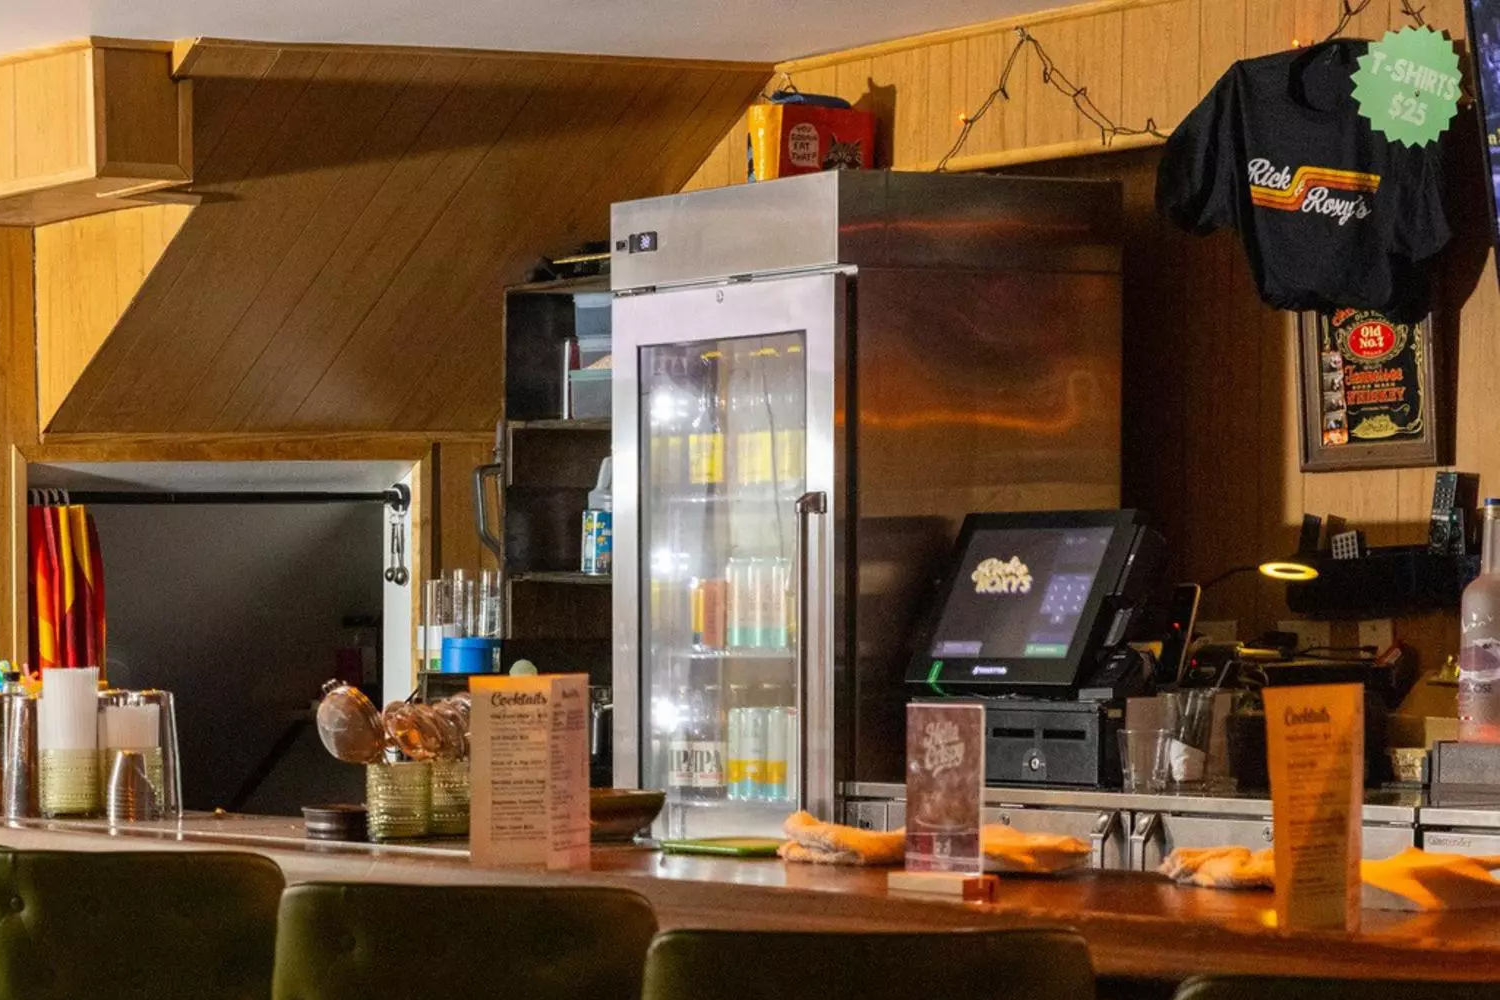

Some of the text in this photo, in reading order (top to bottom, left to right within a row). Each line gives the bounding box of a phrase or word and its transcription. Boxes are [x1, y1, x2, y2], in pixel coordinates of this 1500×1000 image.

[1370, 50, 1457, 101] T-SHIRTS
[1388, 92, 1428, 126] $25
[1247, 158, 1292, 190] Rick
[1302, 186, 1372, 226] Roxy's
[1359, 337, 1384, 349] No.7
[1360, 325, 1382, 337] Old
[490, 691, 548, 706] Cocktails
